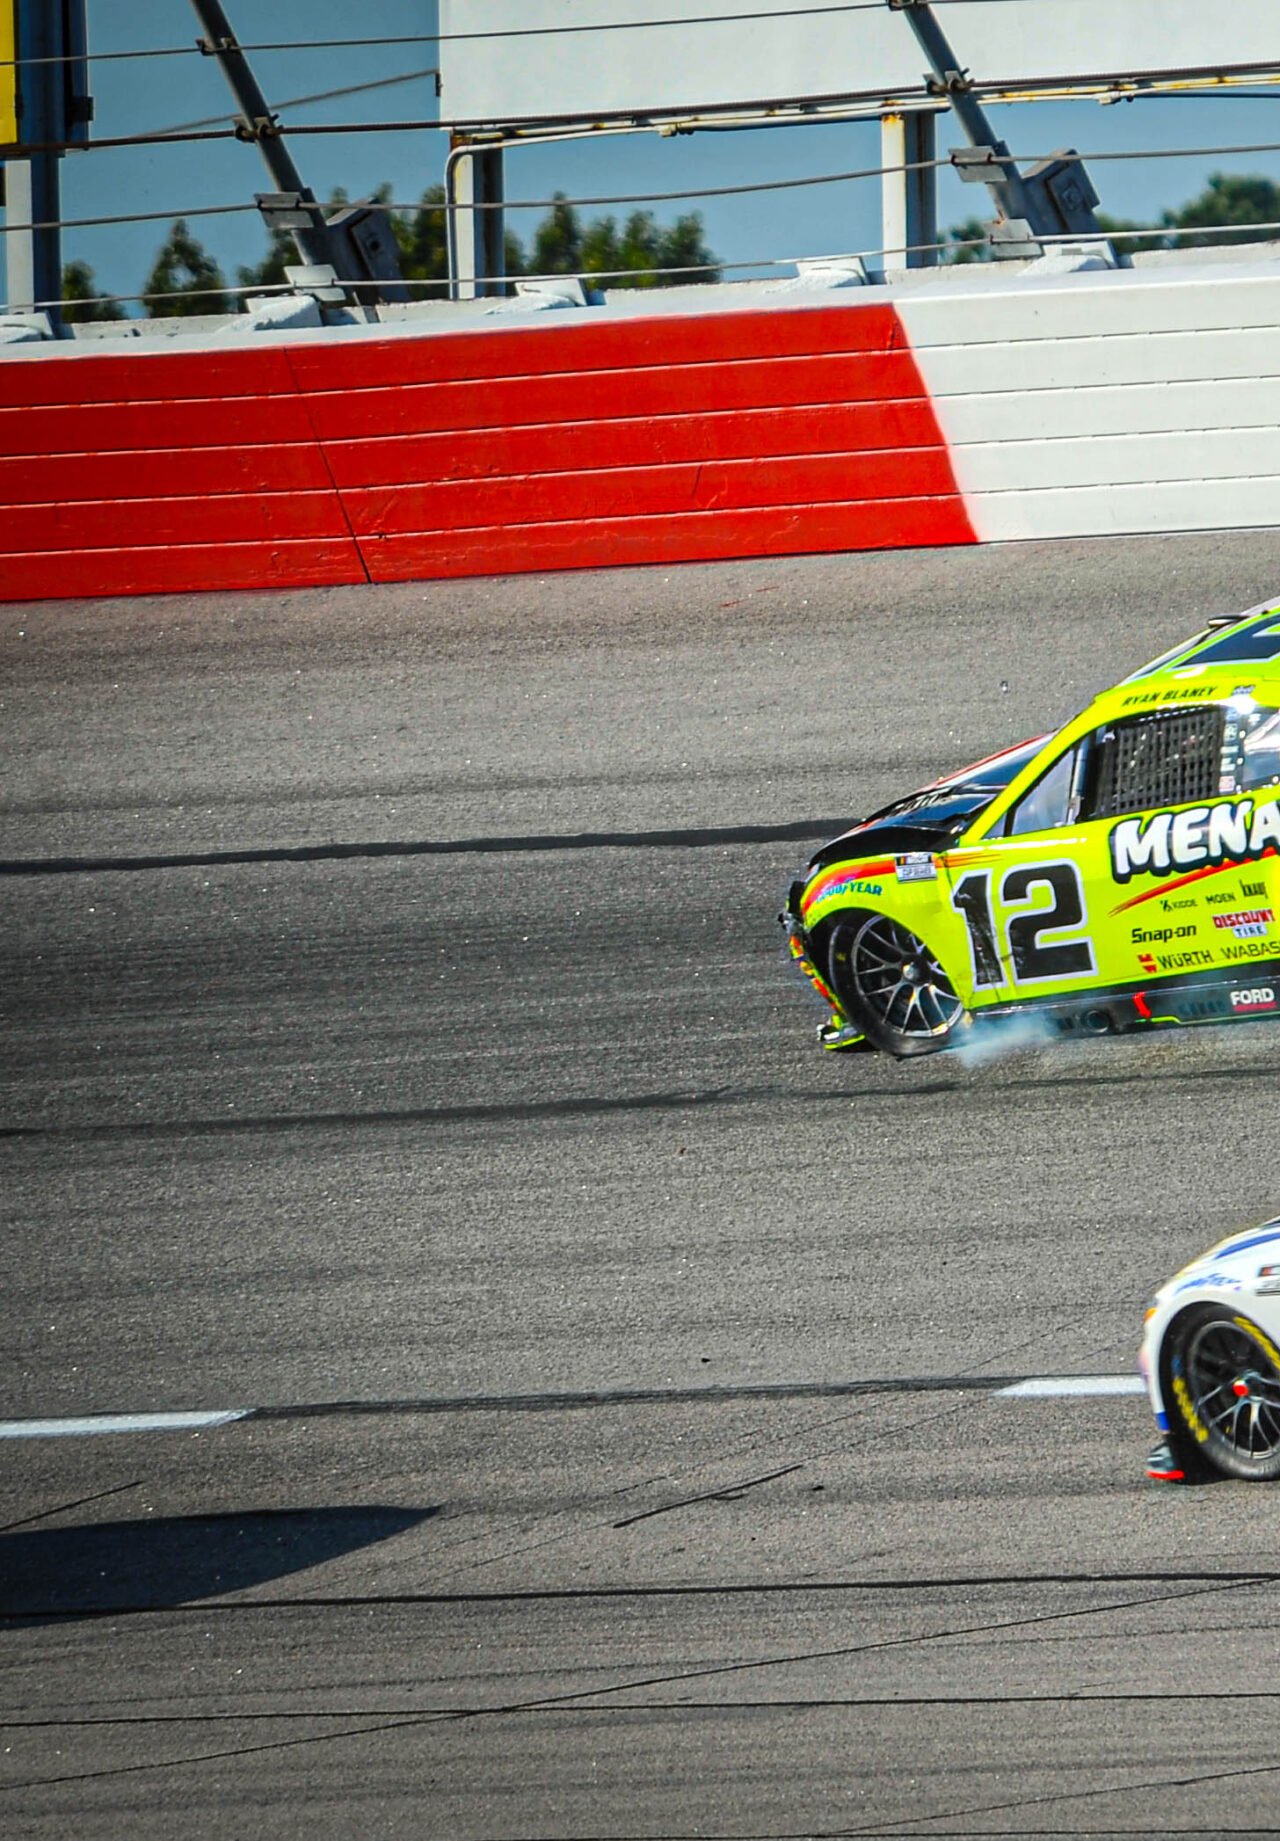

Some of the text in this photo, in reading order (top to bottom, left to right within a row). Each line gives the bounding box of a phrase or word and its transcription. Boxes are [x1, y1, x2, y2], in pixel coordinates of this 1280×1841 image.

[1205, 892, 1236, 905] MOEN
[950, 859, 1098, 991] 12
[1211, 908, 1275, 929] DISCOUNT
[1234, 926, 1265, 938] TIRE
[1230, 987, 1275, 1006] FORD
